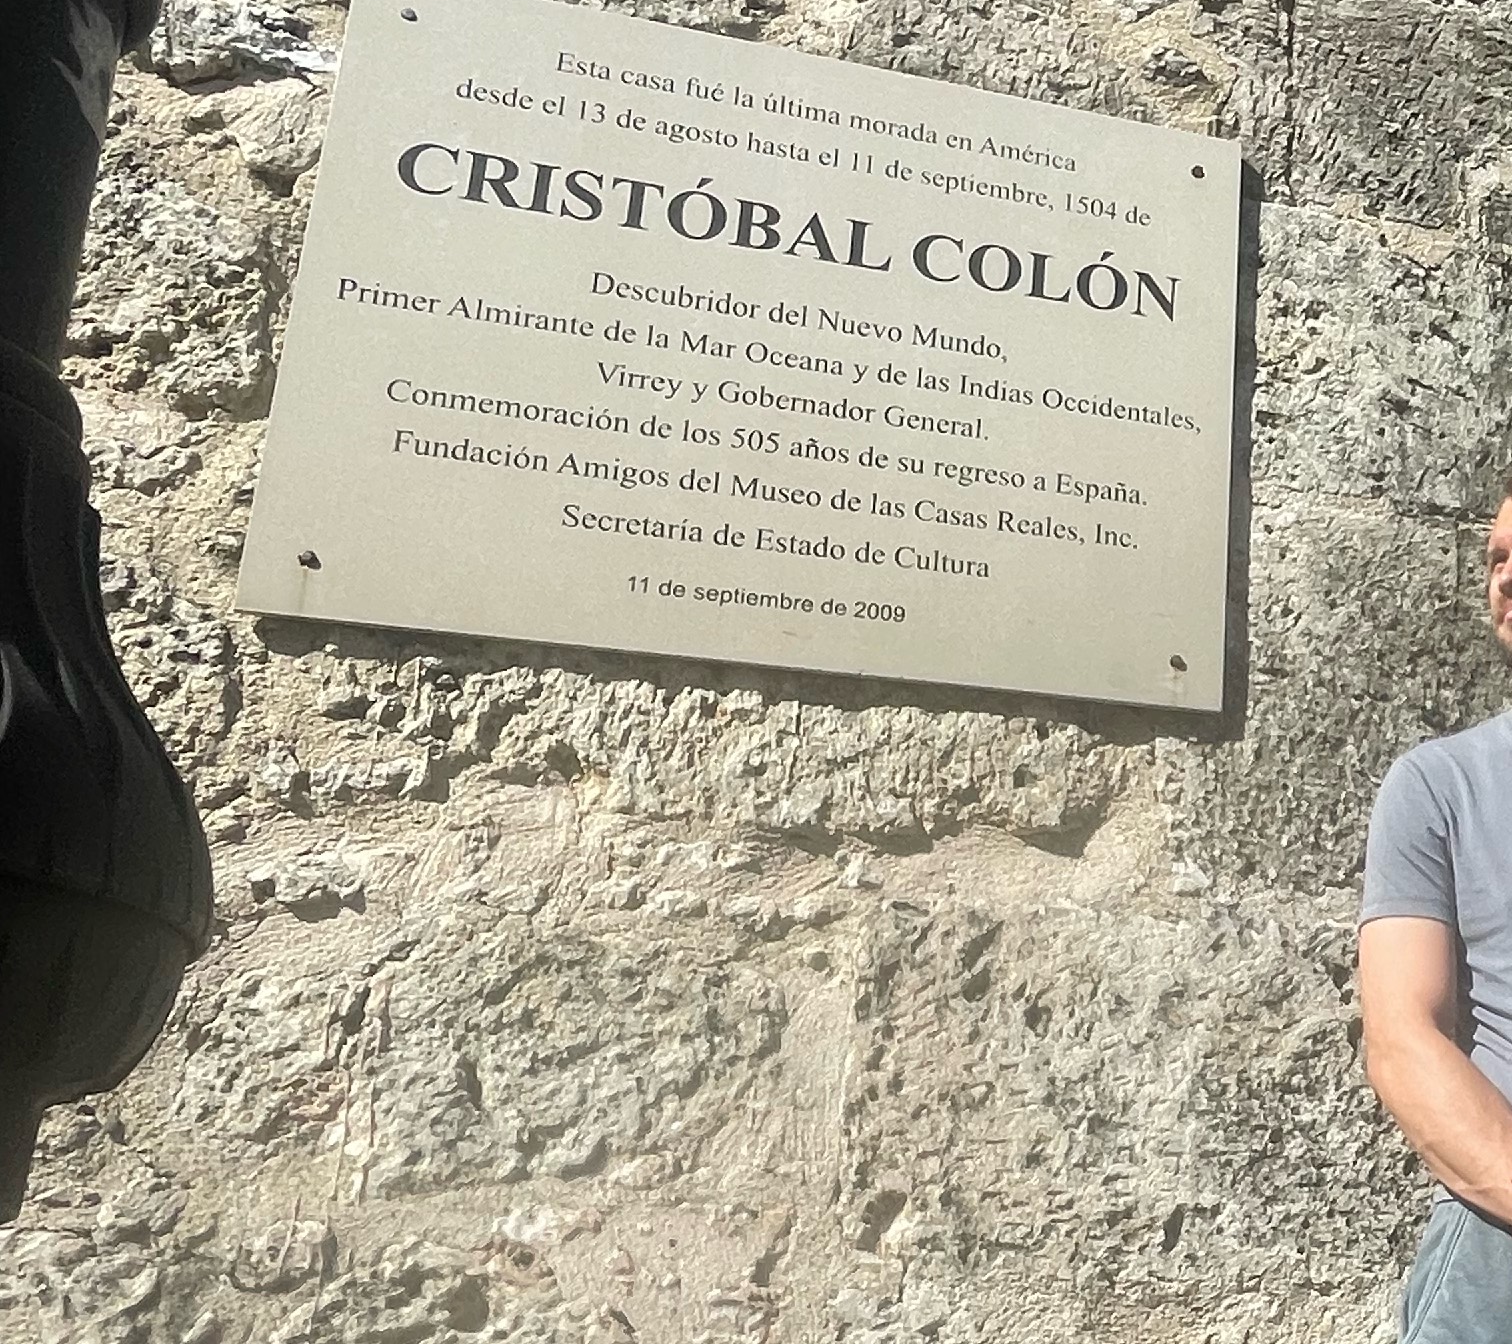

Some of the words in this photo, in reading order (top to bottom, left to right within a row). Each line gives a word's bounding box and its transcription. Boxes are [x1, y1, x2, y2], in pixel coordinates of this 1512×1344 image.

[455, 78, 534, 110] desde
[542, 95, 566, 117] el
[579, 100, 606, 124] 13
[615, 108, 647, 131] de
[654, 119, 738, 148] agosto
[746, 131, 810, 162] hasta
[818, 148, 840, 168] el
[850, 152, 874, 176] 11
[884, 159, 913, 182] de
[920, 170, 1054, 212] septiembre,
[1065, 193, 1117, 221] 1504
[1124, 205, 1152, 227] de
[556, 51, 611, 81] Esta
[620, 70, 675, 94] casa
[686, 76, 725, 103] fué
[733, 86, 754, 109] la
[762, 92, 840, 126] última
[849, 114, 938, 145] morada
[945, 134, 972, 152] en
[978, 136, 1076, 172] América
[397, 142, 893, 272] CRISTÓBAL
[912, 234, 1182, 323] COLÓN
[336, 277, 442, 314] Primer
[446, 296, 594, 338] Almirante
[603, 319, 637, 344] de
[645, 324, 669, 349] la
[680, 330, 738, 359] Mar
[745, 341, 844, 376] Oceana
[851, 363, 870, 385] y
[877, 362, 908, 386] de
[916, 366, 950, 393] las
[960, 374, 1034, 406] Indias
[1042, 388, 1202, 436] Occidentales,
[591, 271, 762, 320] Descubridor
[768, 301, 808, 328] del
[817, 308, 903, 343] Nuevo
[911, 323, 1008, 364] Mundo,
[386, 378, 629, 434] Conmemoración
[639, 414, 673, 440] de
[681, 418, 721, 446] los
[730, 427, 781, 454] 505
[788, 437, 850, 464] años
[858, 445, 889, 470] de
[896, 456, 924, 475] su
[932, 461, 1026, 489] regreso
[1032, 476, 1047, 492] a
[1055, 472, 1147, 506] España.
[596, 360, 683, 400] Virrey
[690, 382, 709, 404] y
[718, 380, 877, 424] Gobernador
[883, 405, 989, 441] General.
[392, 429, 549, 473] Fundación
[555, 452, 670, 490] Amigos
[678, 468, 721, 494] del
[730, 474, 822, 508] Museo
[830, 488, 862, 513] de
[870, 492, 906, 519] las
[914, 499, 988, 530] Casas
[996, 510, 1086, 546] Reales,
[1094, 523, 1138, 550] Inc.
[561, 504, 704, 544] Secretaría
[712, 522, 746, 548] de
[754, 528, 846, 561] Estado
[854, 540, 886, 566] de
[894, 546, 990, 578] Cultura
[627, 575, 649, 594] 11
[658, 579, 686, 598] de
[692, 586, 814, 616] septiembre
[820, 597, 848, 617] de
[853, 600, 906, 623] 2009
